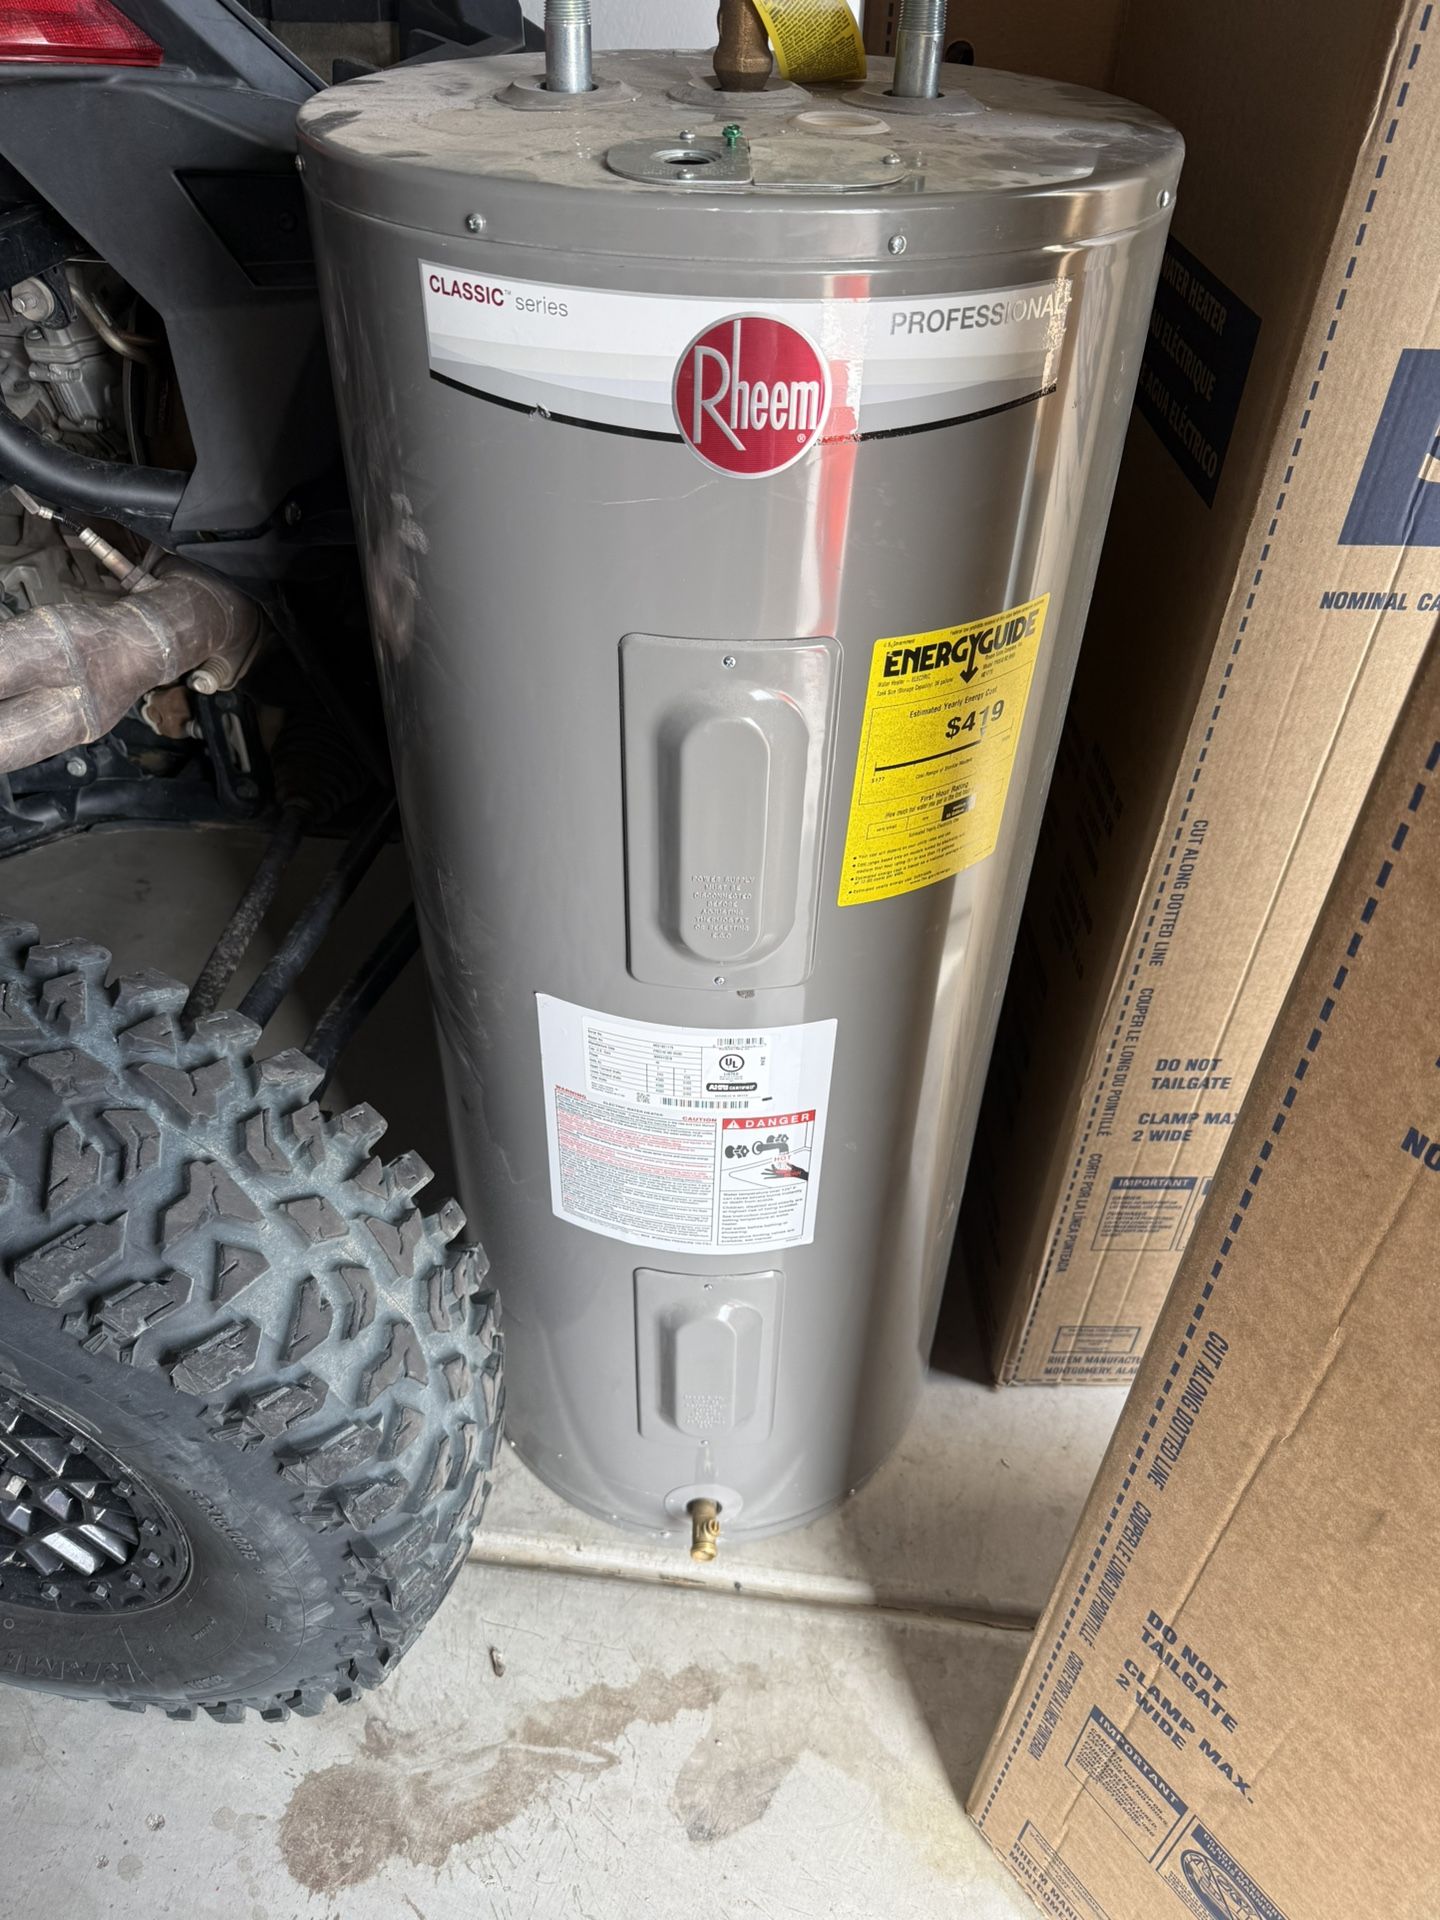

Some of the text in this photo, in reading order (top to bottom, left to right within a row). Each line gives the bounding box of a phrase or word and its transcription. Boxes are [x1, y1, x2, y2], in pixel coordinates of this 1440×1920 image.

[515, 296, 568, 318] series
[889, 292, 1064, 336] PROFESSIONAL
[1190, 278, 1228, 336] HEATER
[693, 319, 819, 452] Rheem
[1319, 591, 1408, 611] NOMINAL
[883, 608, 1039, 680] ENERGYGUIDE
[909, 704, 942, 719] Estimated
[943, 697, 964, 711] Yearly
[964, 690, 984, 705] Energy
[920, 781, 969, 802] First Hour Rating
[1149, 819, 1209, 967] CUT ALONG DOTTED LINE
[1130, 987, 1154, 1028] COUPER
[1125, 1029, 1142, 1043] LE
[1116, 1045, 1136, 1072] LONG
[1155, 1058, 1222, 1071] DO NOT
[1112, 1073, 1127, 1087] DU
[1151, 1077, 1232, 1090] TAILGATE
[682, 1115, 717, 1123] CAUTION
[745, 1112, 810, 1128] DANGER
[1138, 1112, 1199, 1125] CLAMP
[1131, 1129, 1193, 1142] 2 WIDE
[1118, 1179, 1189, 1187] IMPORTANT
[1147, 1330, 1229, 1492] CUT ALONG DOTTED LINE
[1121, 1500, 1152, 1549] COUPER
[1115, 1539, 1135, 1563] LE
[1104, 1553, 1128, 1590] LONG
[1098, 1580, 1116, 1604] DU
[1147, 1609, 1228, 1693] DO NOT
[1141, 1625, 1238, 1733] TAILGATE
[1124, 1658, 1196, 1734] CLAMP
[1116, 1673, 1186, 1751] 2 WIDE
[1098, 1715, 1179, 1804] IMPORTANT
[1013, 1842, 1048, 1886] RHEEM
